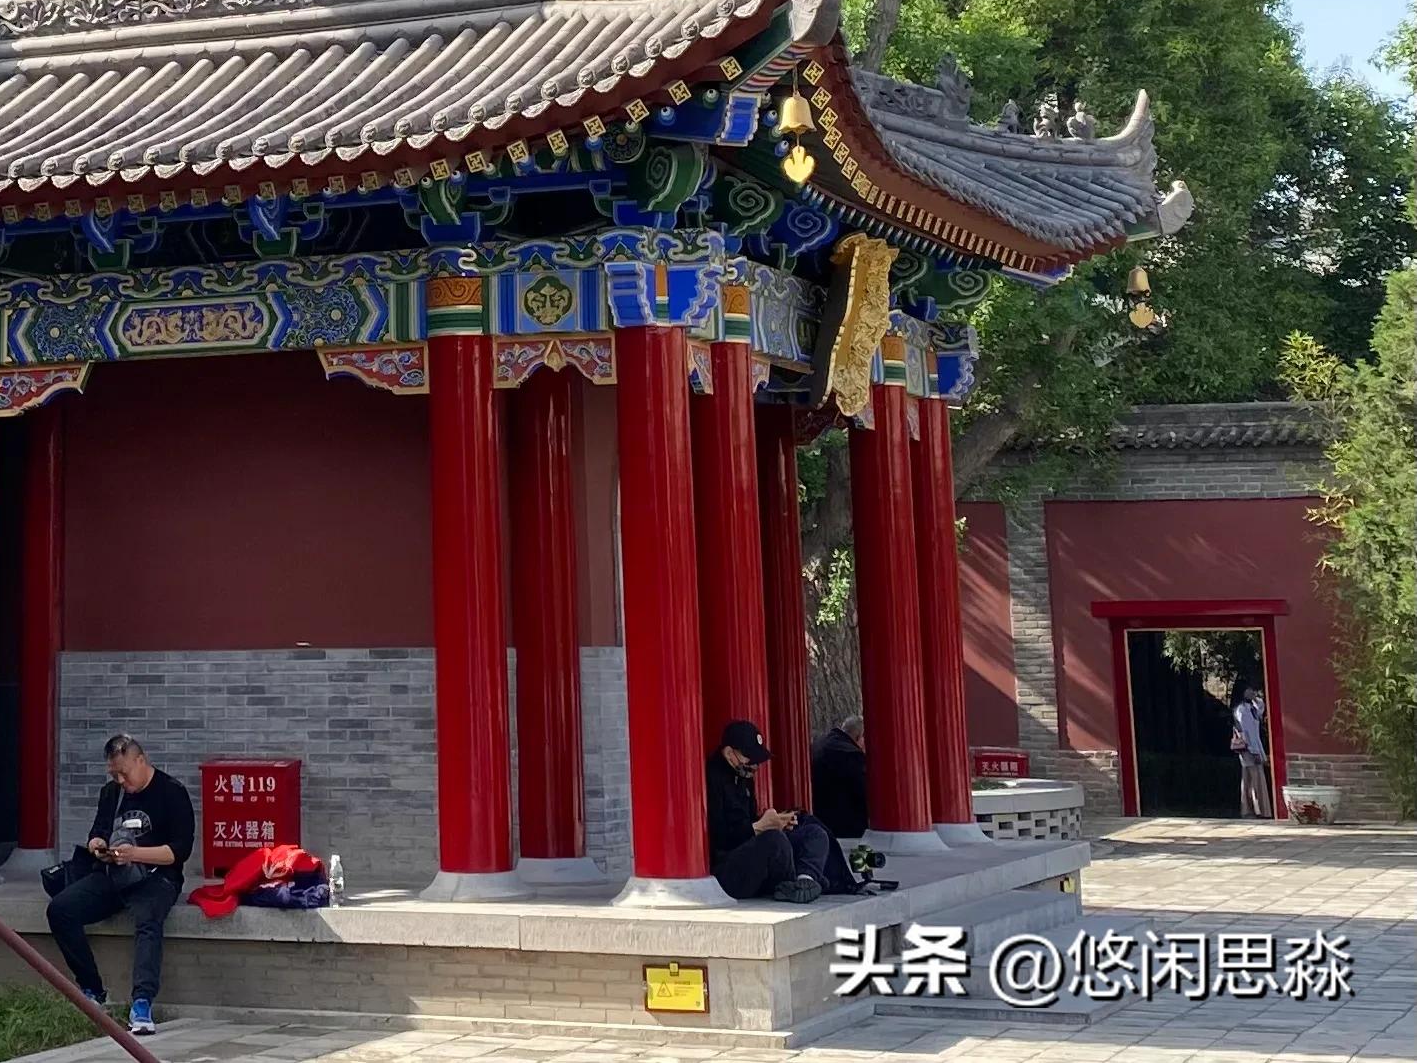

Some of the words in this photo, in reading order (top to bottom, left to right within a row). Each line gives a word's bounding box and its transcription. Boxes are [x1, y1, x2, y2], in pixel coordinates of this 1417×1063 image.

[213, 774, 276, 794] 火警119
[213, 820, 276, 840] 灭火器箱
